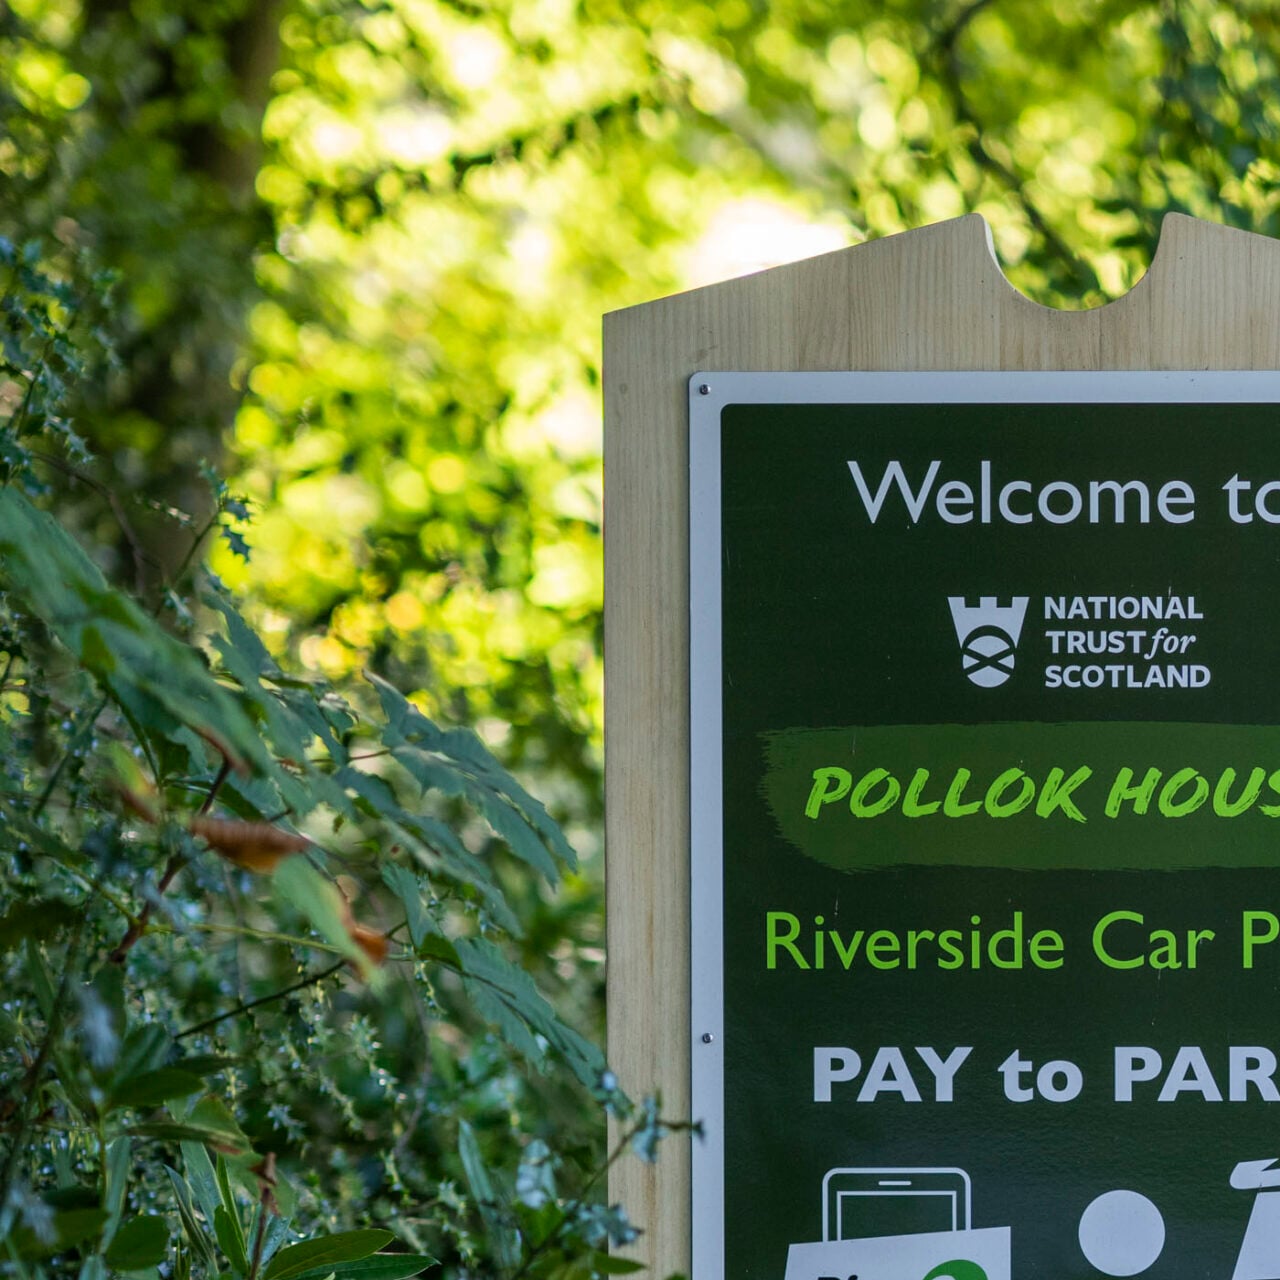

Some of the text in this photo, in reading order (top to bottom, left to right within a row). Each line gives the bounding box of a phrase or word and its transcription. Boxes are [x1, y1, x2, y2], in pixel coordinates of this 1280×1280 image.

[847, 460, 1195, 524] Welcome
[1044, 596, 1204, 620] NATIONAL
[1045, 627, 1197, 660] TRUST for
[1045, 664, 1211, 688] SCOTLAND
[804, 765, 1093, 824] POLLOK
[766, 911, 1064, 970] Riverside
[1092, 910, 1216, 970] Car
[813, 1046, 974, 1102] PAY
[997, 1049, 1083, 1103] to
